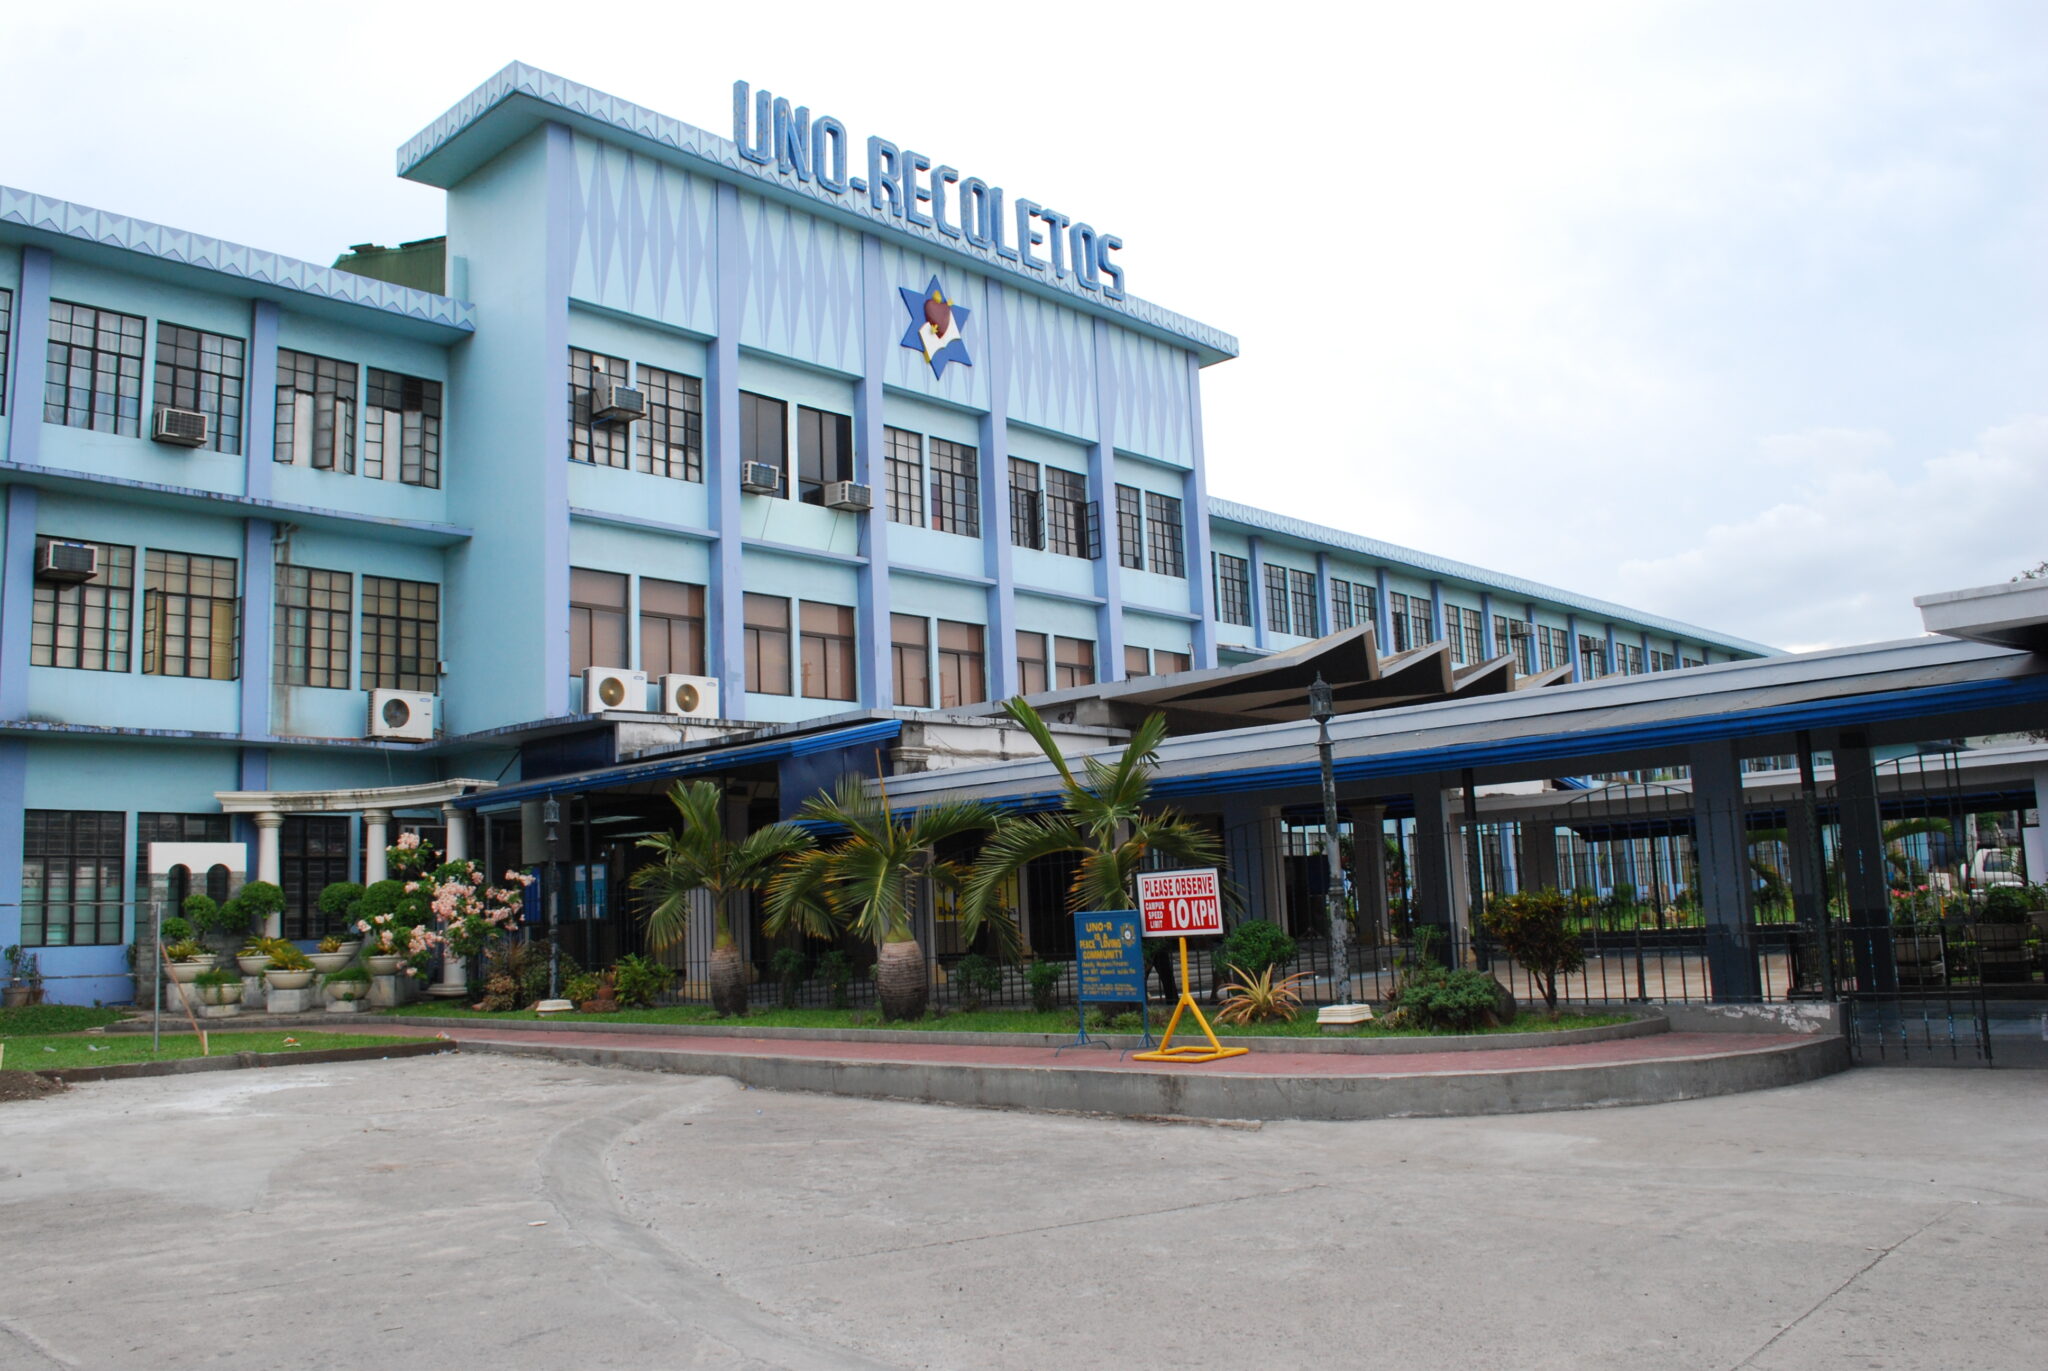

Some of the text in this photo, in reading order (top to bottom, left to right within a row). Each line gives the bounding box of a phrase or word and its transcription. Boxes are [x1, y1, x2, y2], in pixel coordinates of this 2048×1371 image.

[733, 80, 1125, 301] UNO-RECOLETOS
[1144, 876, 1213, 898] PLEASE OBSERVE
[1145, 901, 1165, 911] CAMPUS
[1148, 911, 1164, 920] SPEED
[1168, 898, 1217, 929] 10 KPH
[1085, 922, 1113, 932] UNO-R
[1149, 920, 1163, 929] LIMIT
[1080, 939, 1122, 949] PEACE LOVING
[1082, 950, 1123, 960] COMMUNITY
